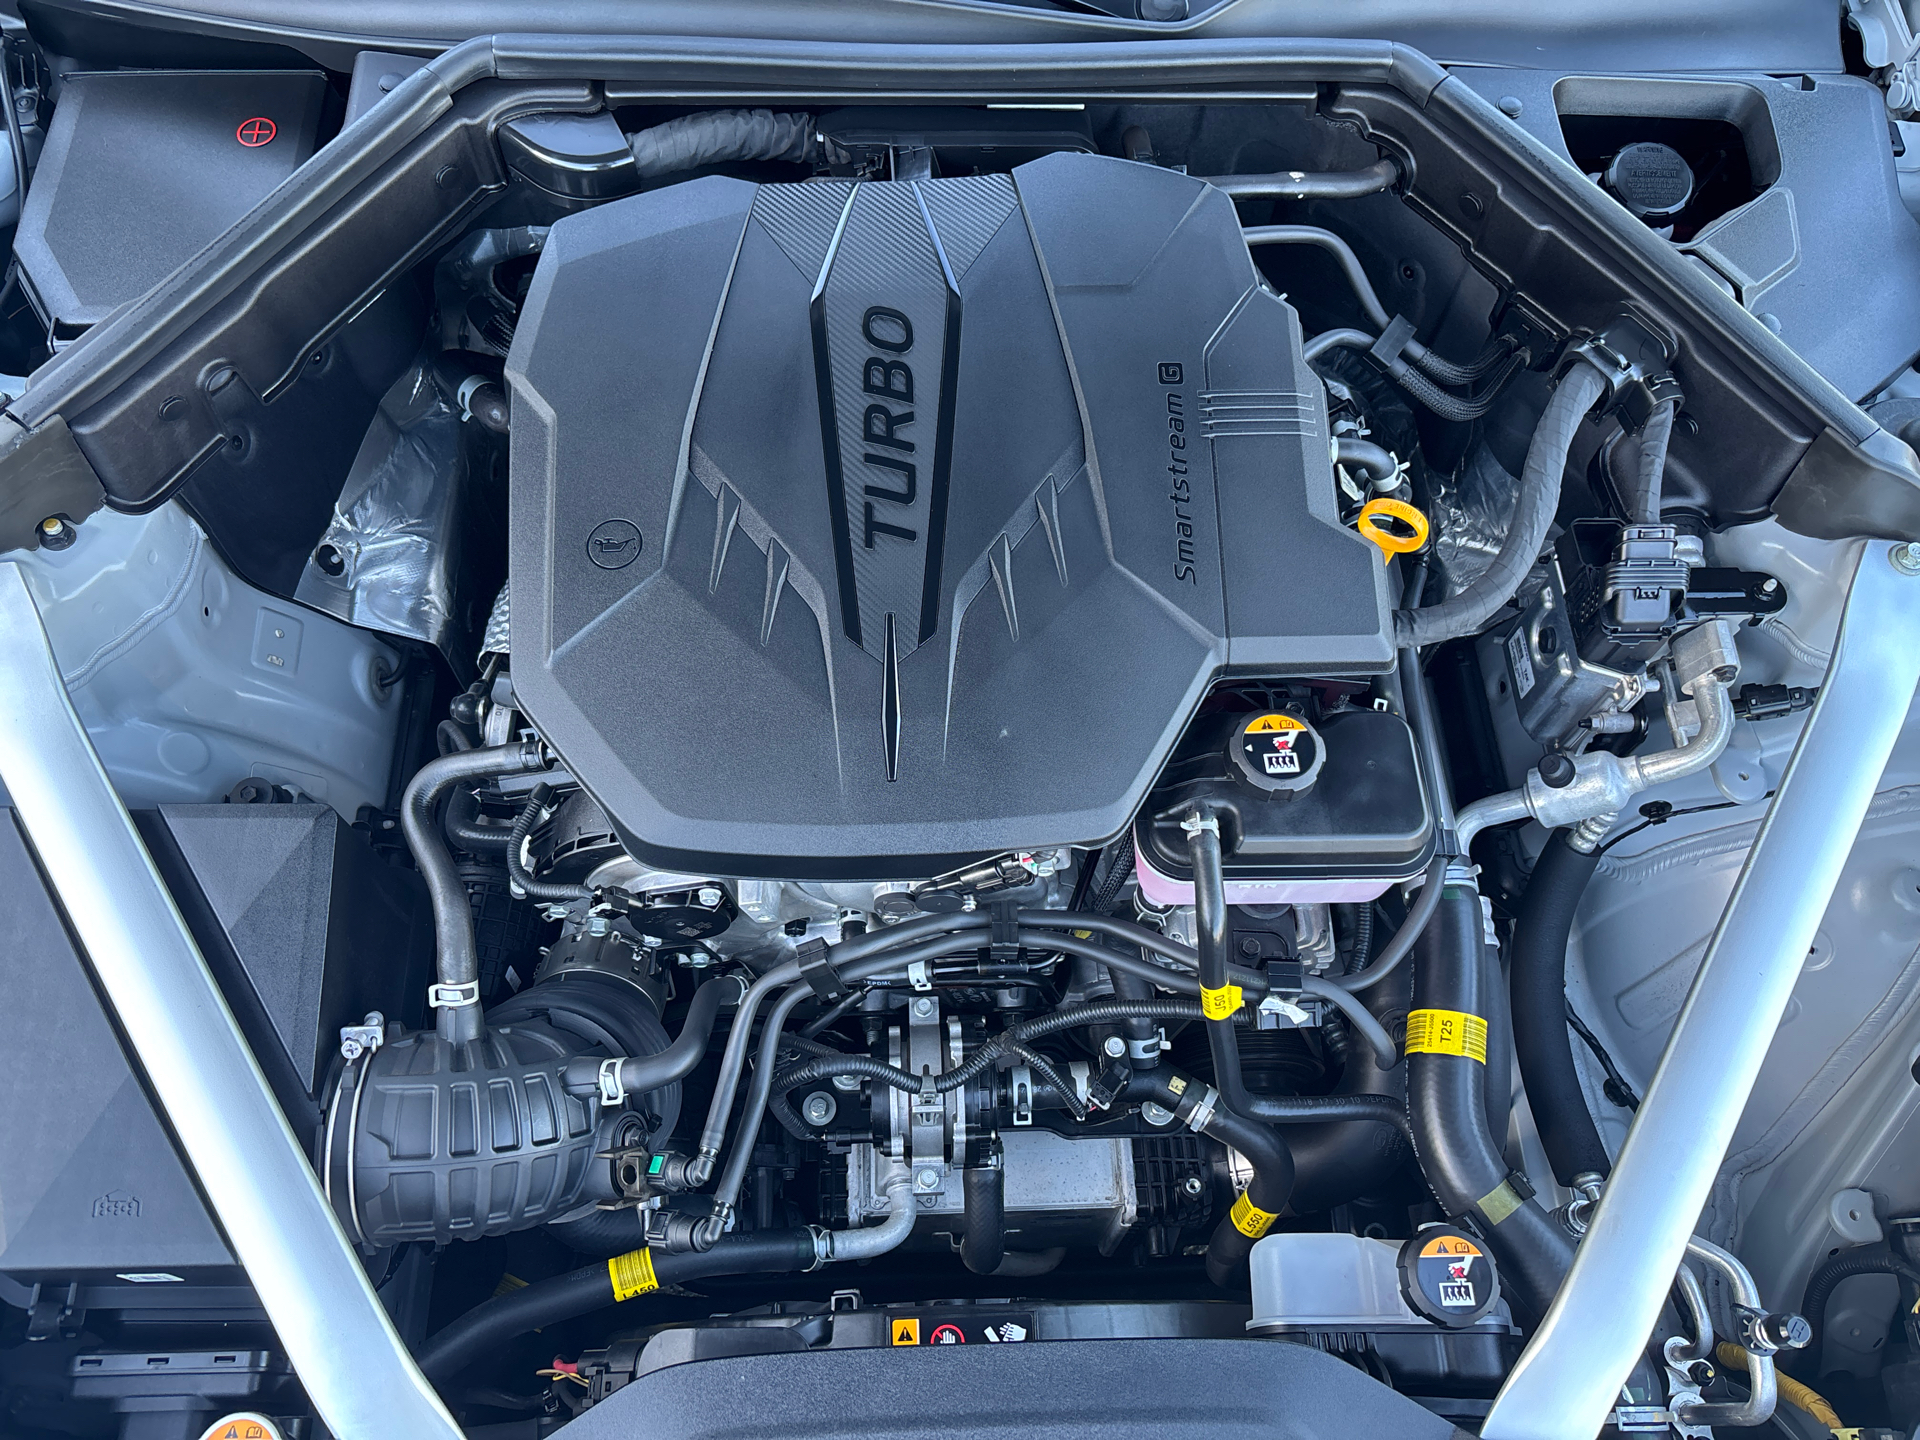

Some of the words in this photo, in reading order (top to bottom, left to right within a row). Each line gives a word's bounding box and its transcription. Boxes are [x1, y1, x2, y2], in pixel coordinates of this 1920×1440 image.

[862, 305, 917, 550] TURBO
[1166, 392, 1197, 586] Smartstream
[1214, 994, 1227, 1012] J50
[1440, 1019, 1453, 1044] T25
[1243, 1213, 1263, 1234] L550
[622, 1284, 656, 1300] L450
